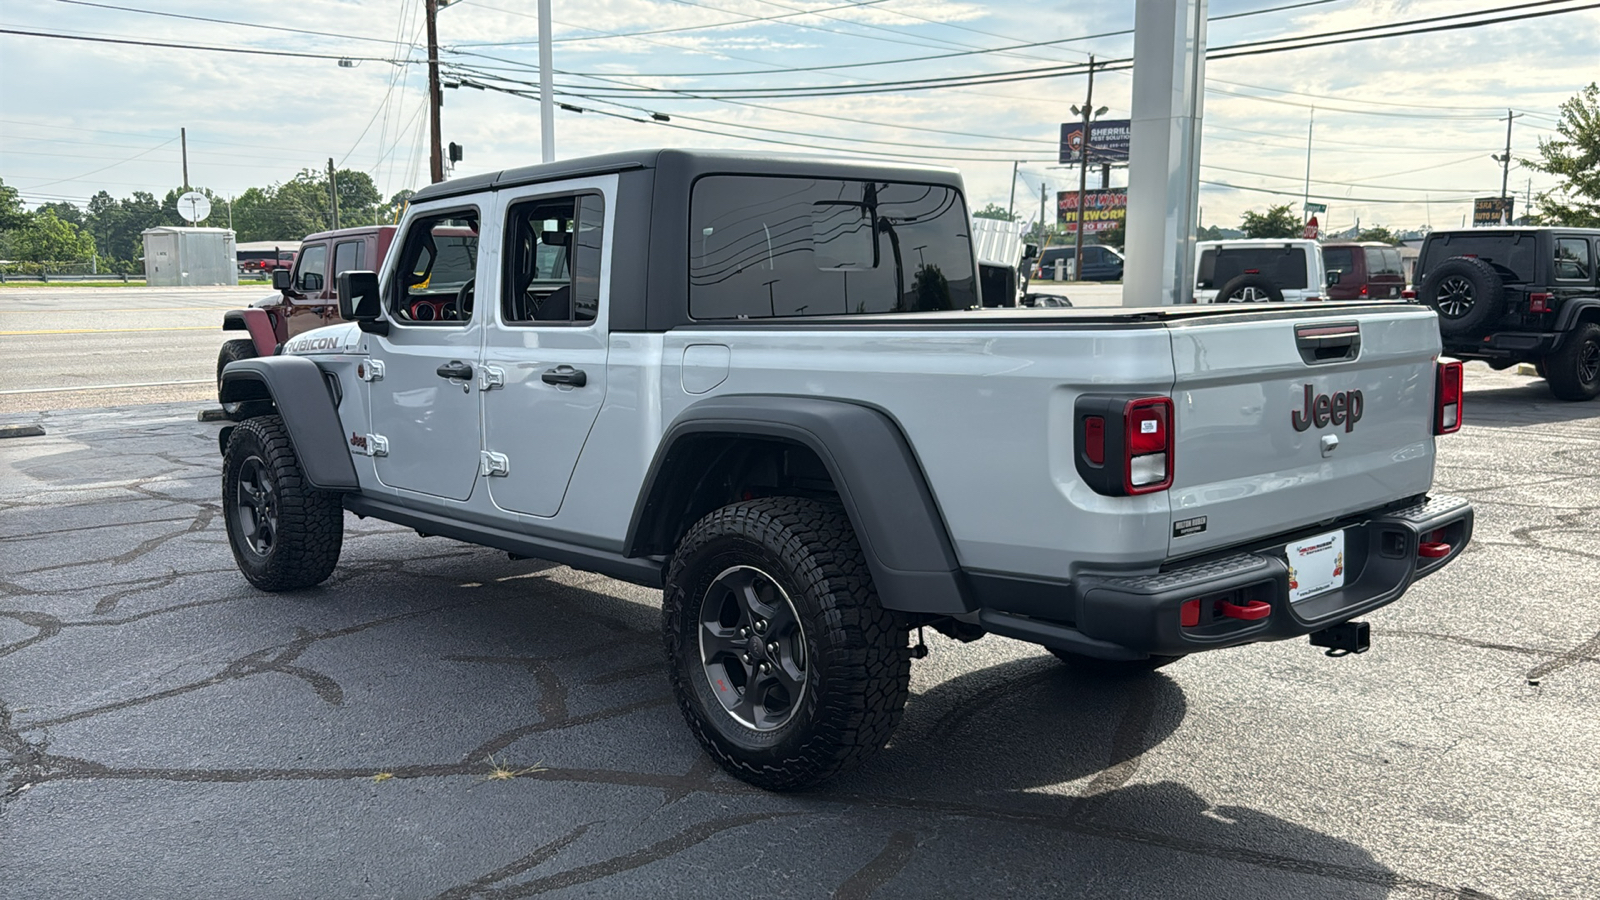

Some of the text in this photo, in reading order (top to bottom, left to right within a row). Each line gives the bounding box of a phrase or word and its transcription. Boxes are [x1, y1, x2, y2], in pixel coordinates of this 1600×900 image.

[1105, 134, 1131, 142] SOLUTIO
[1475, 212, 1490, 220] AUTO
[1303, 225, 1318, 238] STOP
[284, 336, 340, 352] RUBICON
[1291, 383, 1364, 433] Jeep
